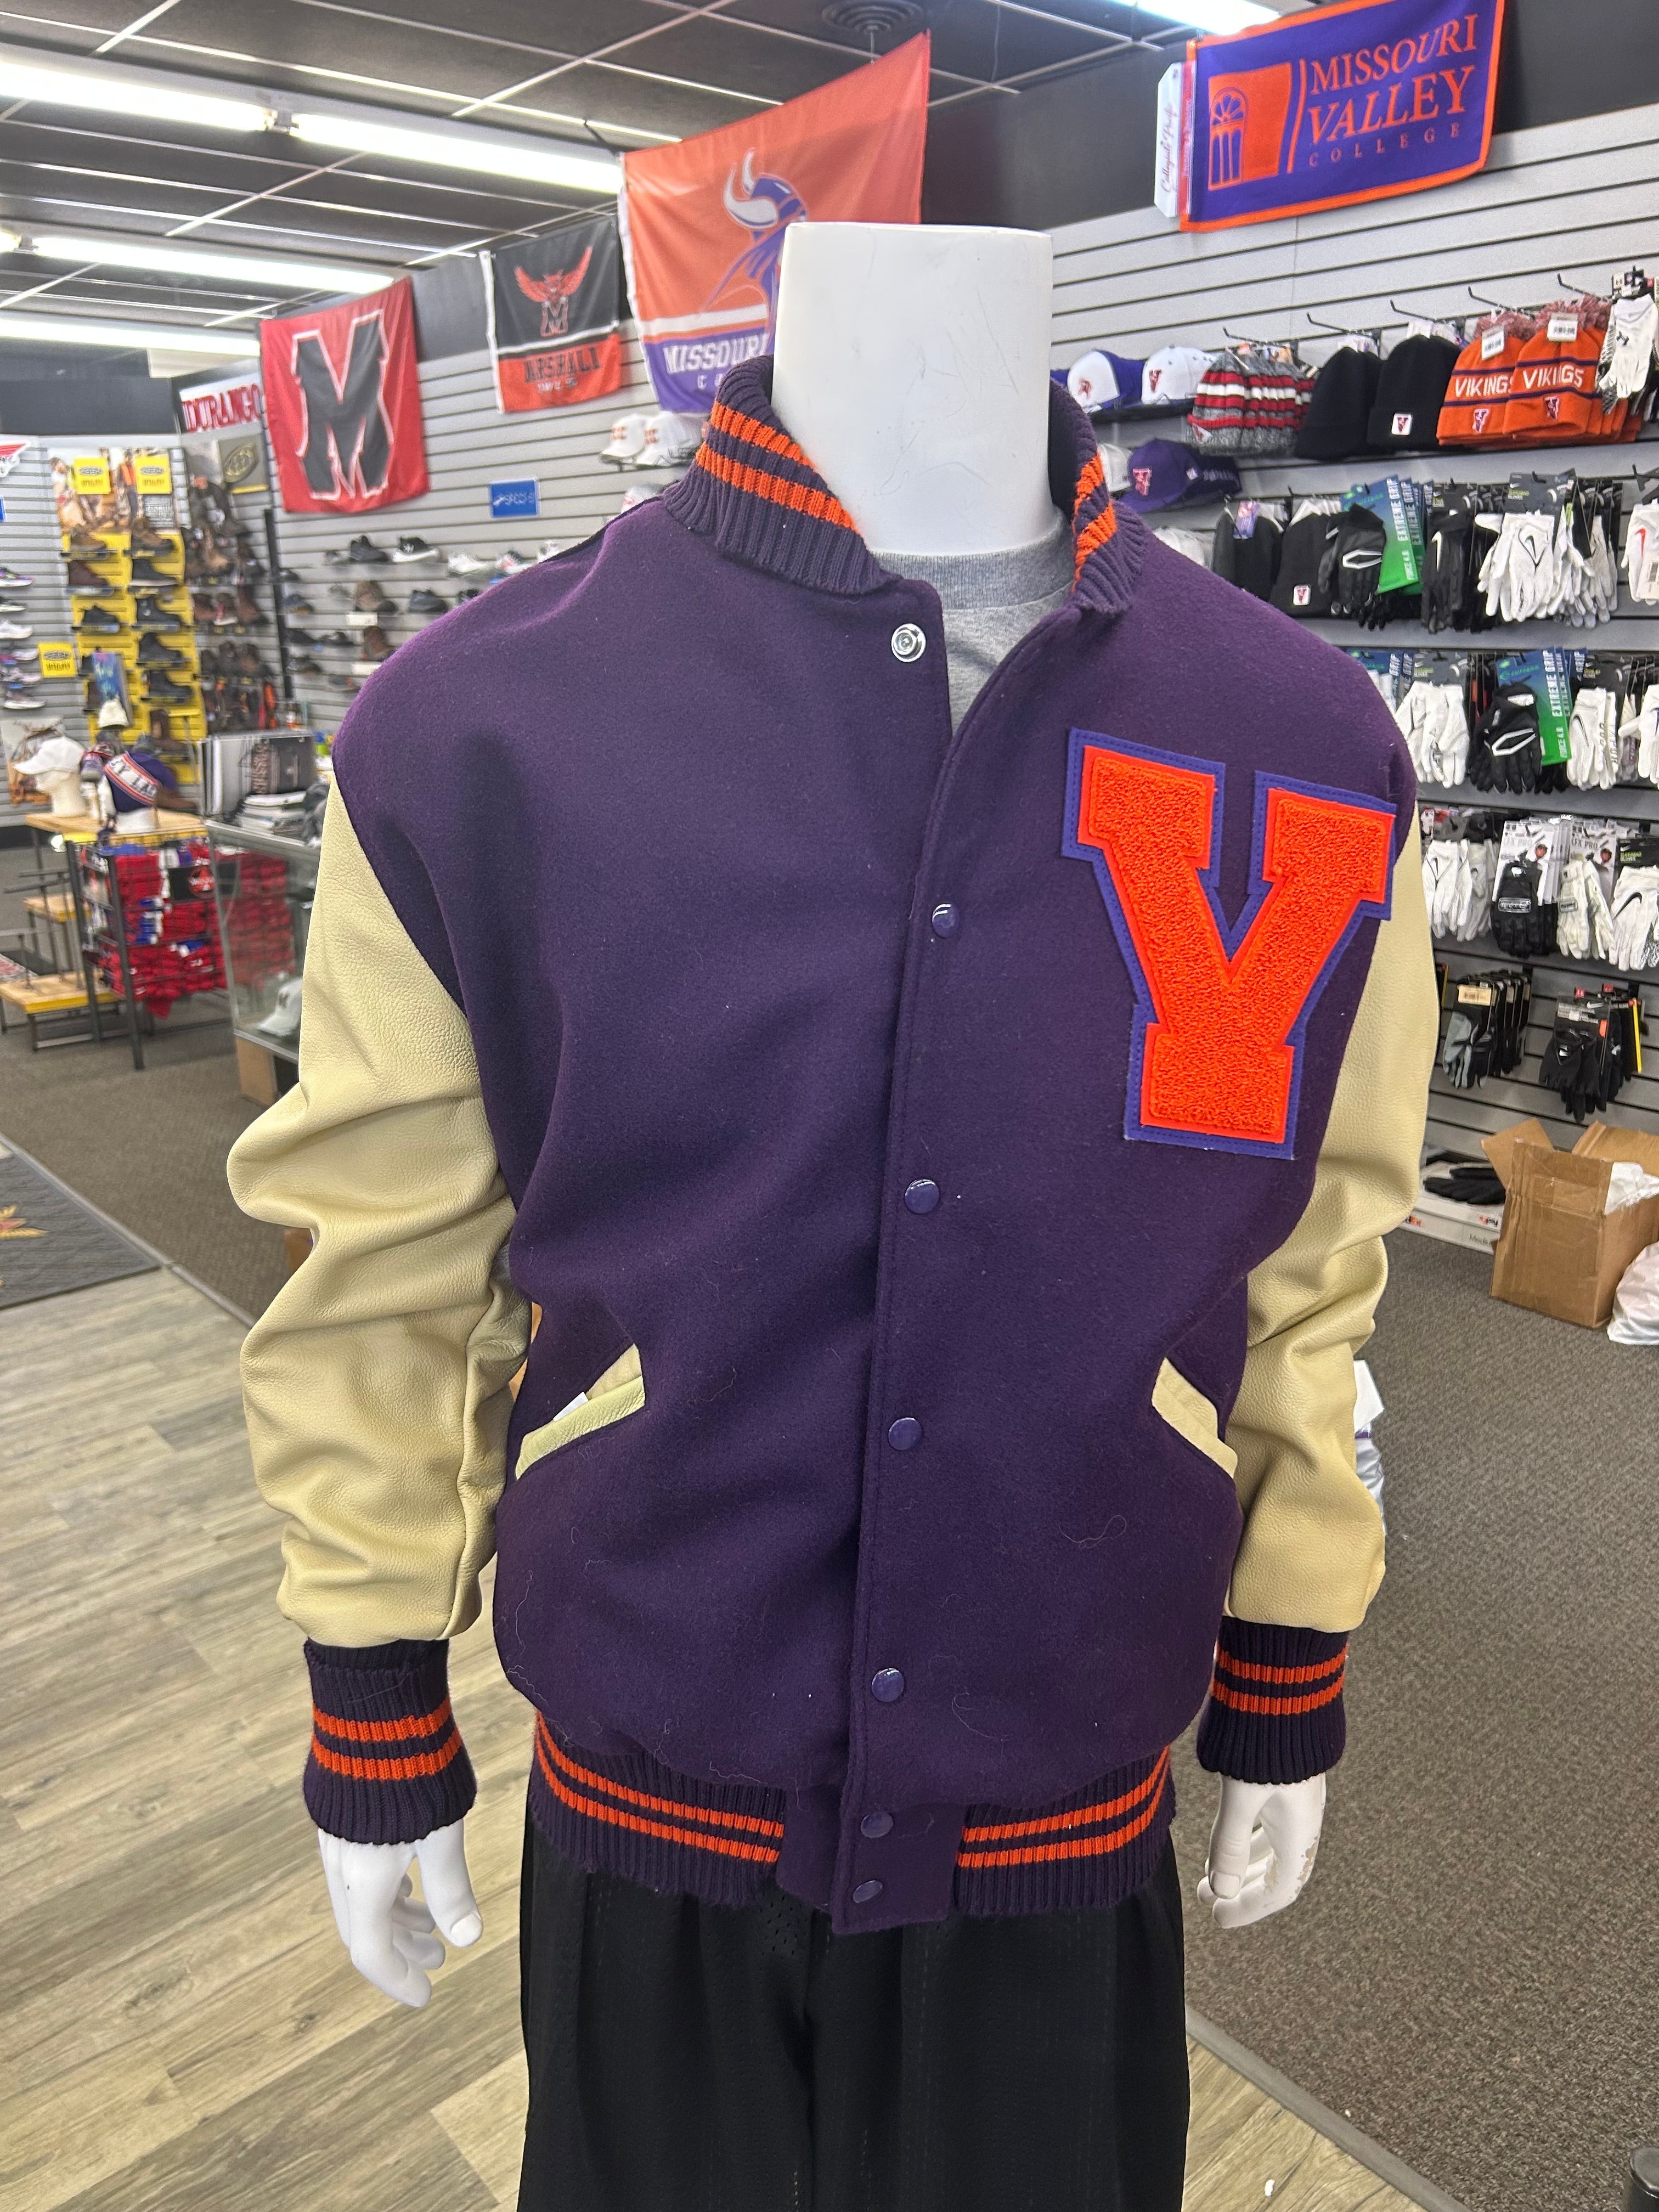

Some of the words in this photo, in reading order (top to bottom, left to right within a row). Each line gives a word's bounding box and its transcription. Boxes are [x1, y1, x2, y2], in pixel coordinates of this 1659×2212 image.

[1310, 14, 1479, 95] MISSOURI
[1308, 65, 1475, 144] VALLEY
[1309, 123, 1460, 167] COLLEGE
[1454, 375, 1512, 398] VIKING
[1542, 650, 1556, 673] GRIP
